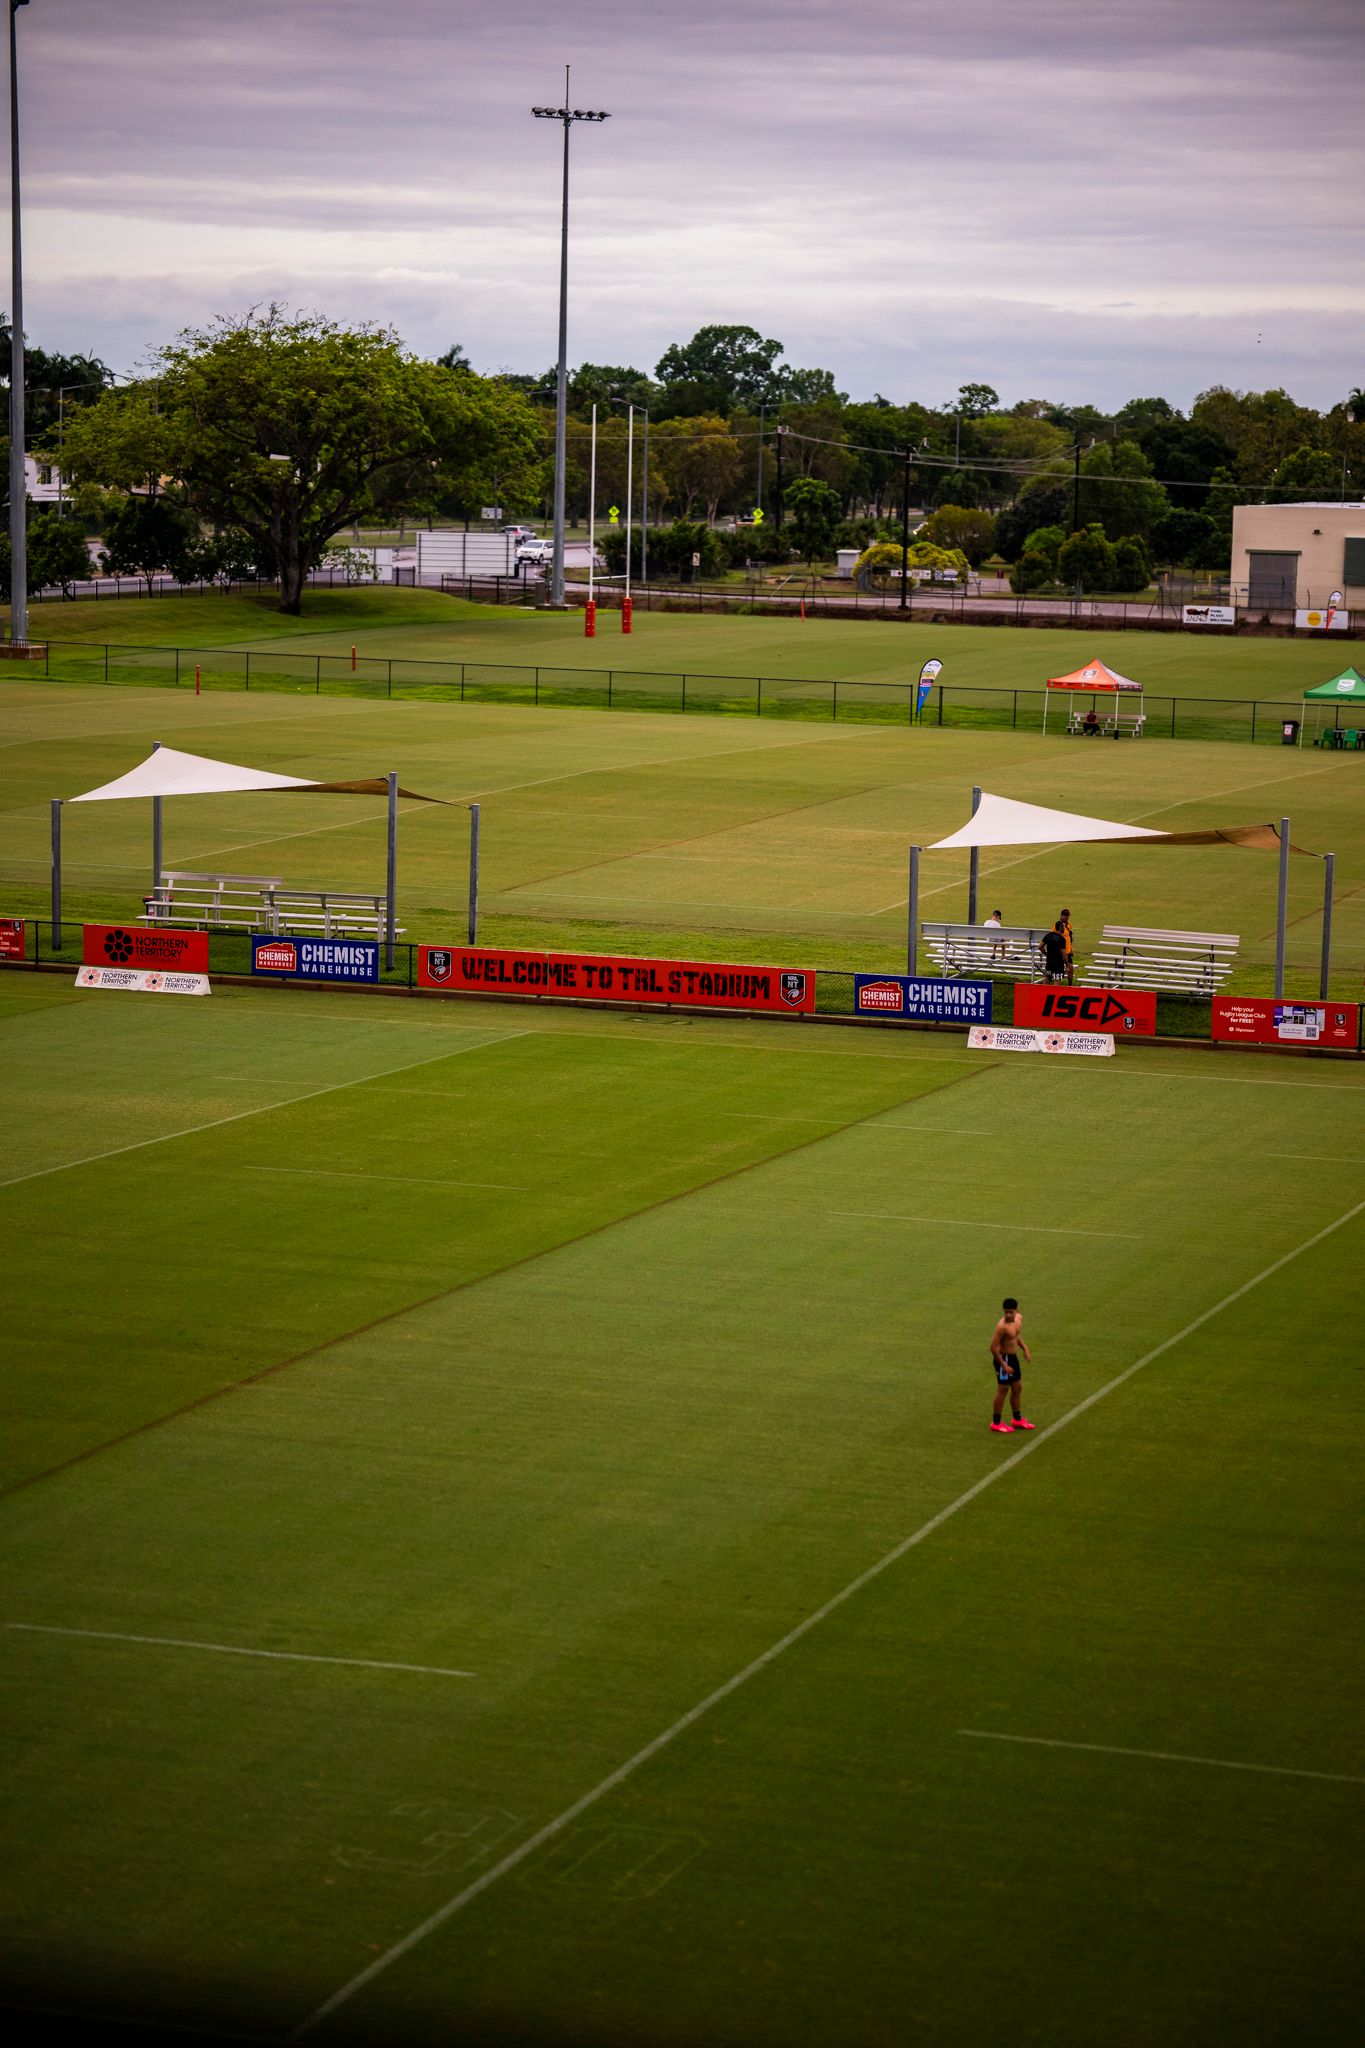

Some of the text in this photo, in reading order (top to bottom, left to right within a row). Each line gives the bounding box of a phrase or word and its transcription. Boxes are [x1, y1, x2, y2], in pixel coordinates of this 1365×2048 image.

[136, 937, 188, 948] NORTHERN
[136, 947, 182, 958] TERRITORY
[258, 952, 294, 962] CHEMIST
[302, 944, 374, 966] CHEMIST
[302, 964, 372, 976] WAREHOUSE
[462, 957, 770, 1000] WELCOME TO TRL STADIUM
[862, 991, 900, 1001] CHEMIST
[908, 984, 988, 1005] CHEMIST
[909, 1003, 984, 1017] WAREHOUSE
